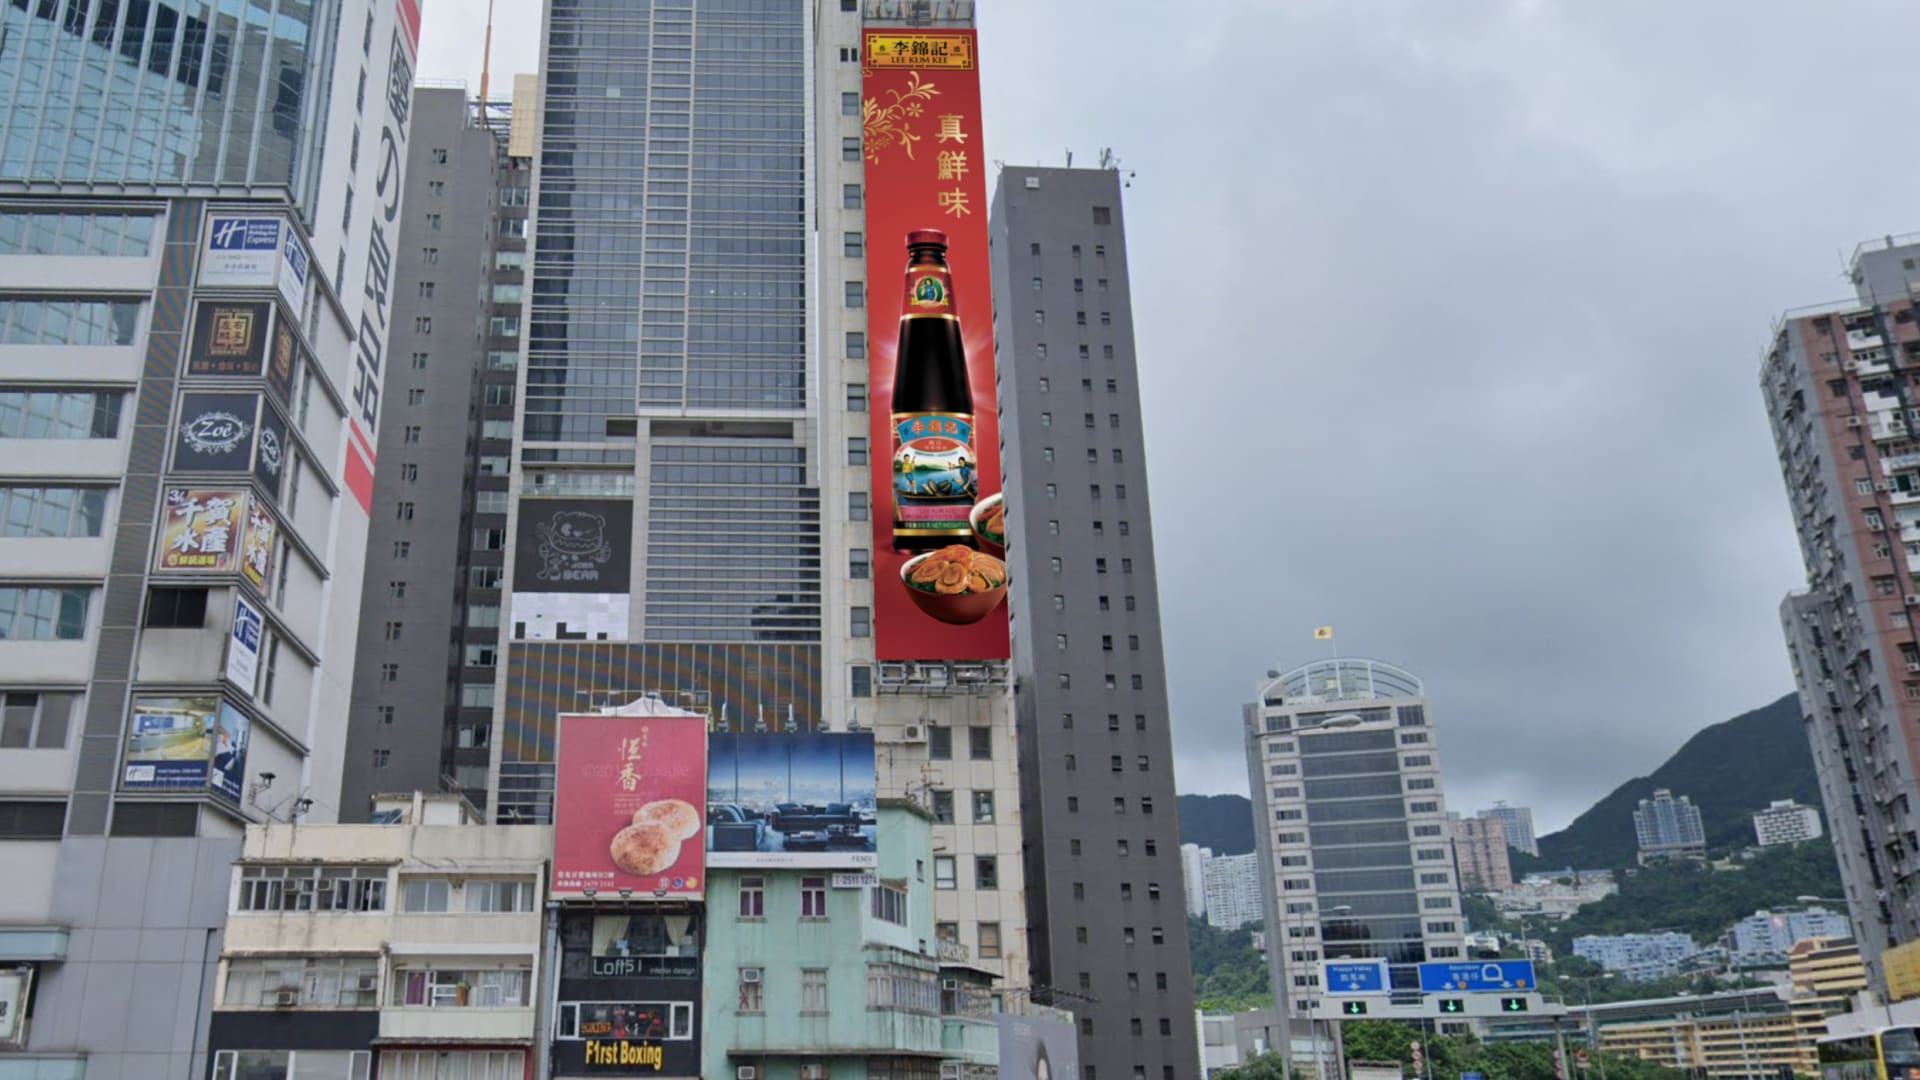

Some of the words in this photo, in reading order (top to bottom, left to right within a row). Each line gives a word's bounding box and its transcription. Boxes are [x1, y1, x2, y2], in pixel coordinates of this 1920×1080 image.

[894, 40, 948, 56] 李錦記
[891, 56, 905, 64] LEE
[909, 56, 930, 64] KUM
[932, 56, 947, 64] KEE
[935, 113, 971, 218] 真鮮味
[247, 235, 276, 245] Express
[585, 1041, 618, 1064] F1rst
[620, 1040, 662, 1071] Boxing
